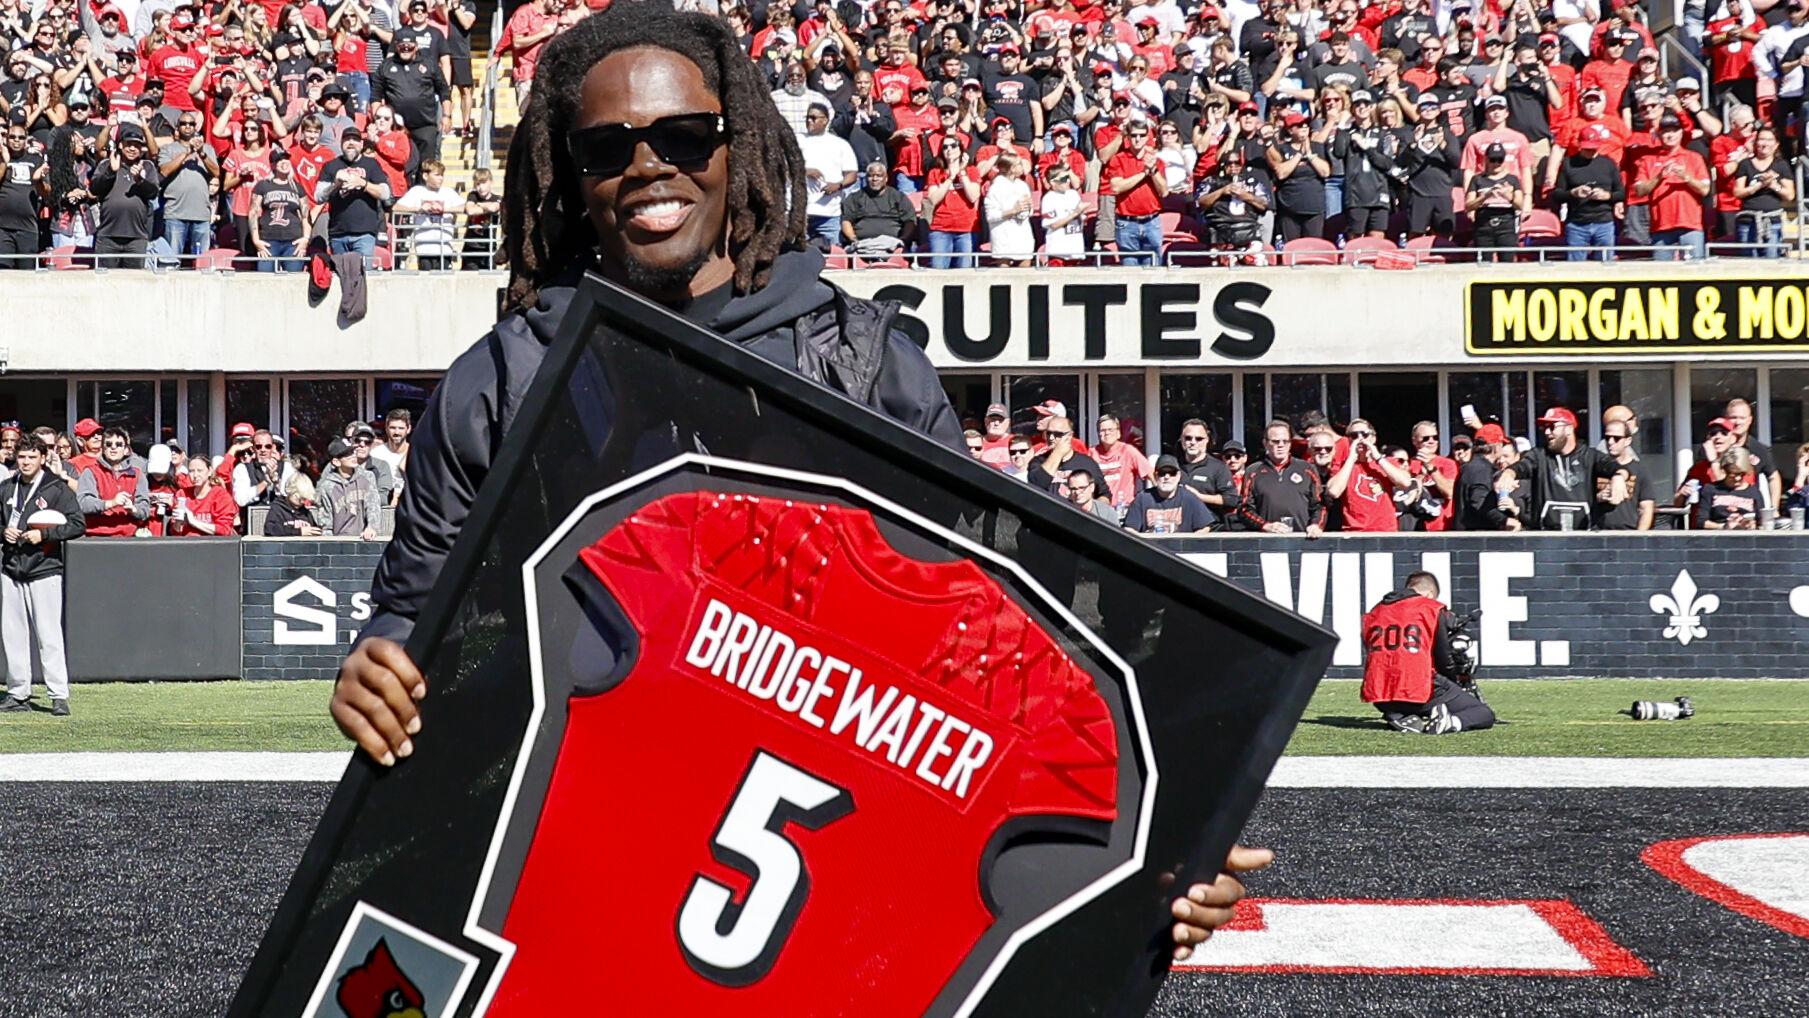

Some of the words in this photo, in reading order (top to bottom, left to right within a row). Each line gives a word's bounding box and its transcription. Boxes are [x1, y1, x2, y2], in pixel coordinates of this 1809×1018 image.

[873, 281, 1276, 361] SUITES
[1491, 286, 1680, 342] MORGAN
[1692, 286, 1727, 340] &
[1738, 284, 1809, 340] MO
[685, 598, 994, 799] BRIDGEWATER
[675, 747, 856, 988] 5
